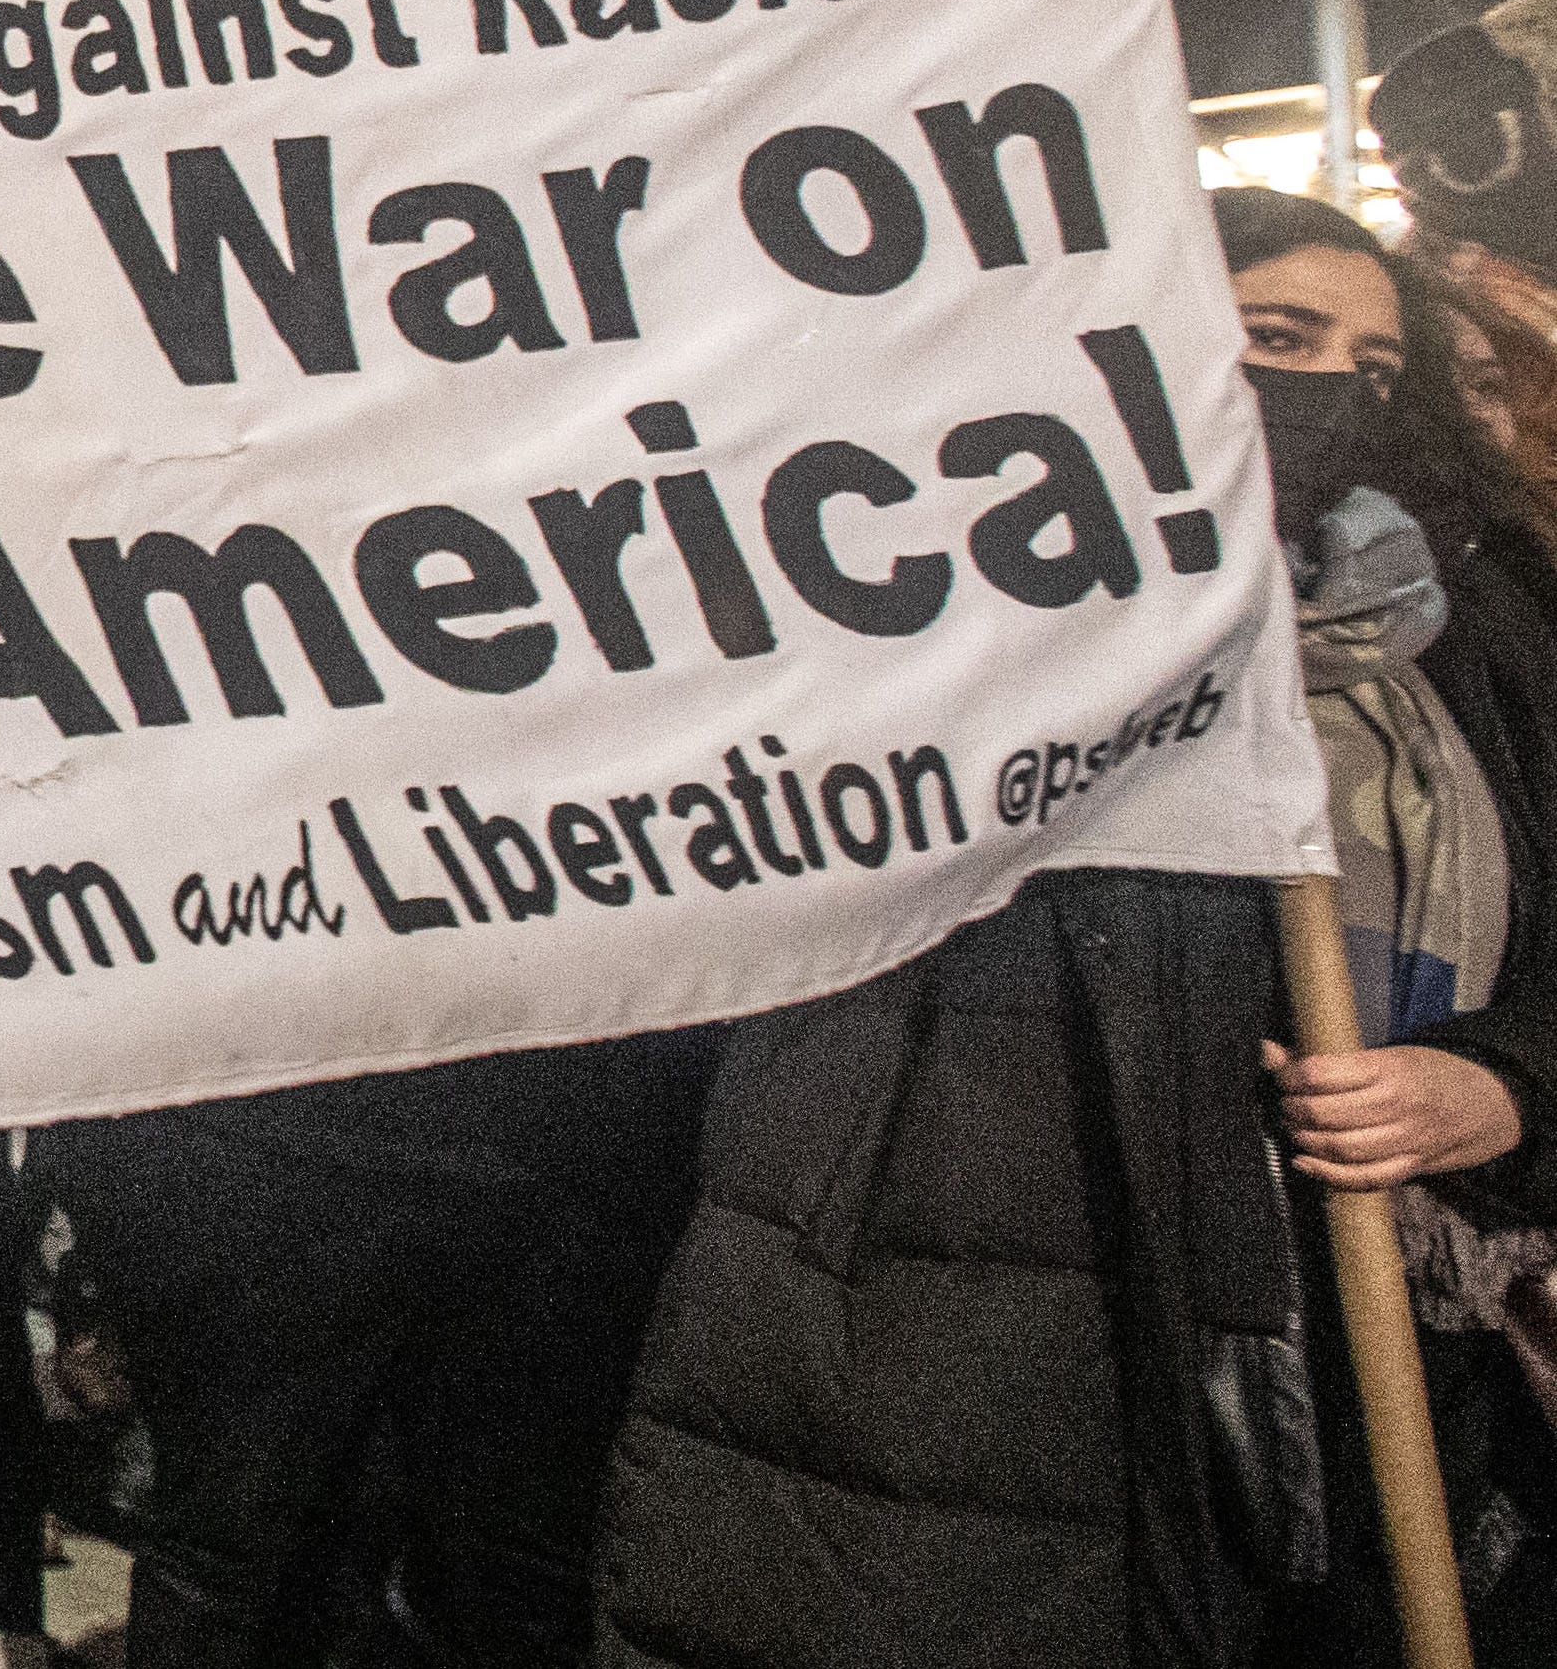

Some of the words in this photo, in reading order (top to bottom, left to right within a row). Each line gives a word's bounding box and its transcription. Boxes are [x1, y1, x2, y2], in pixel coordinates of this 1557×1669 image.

[67, 133, 651, 386] War
[739, 81, 1111, 298] on
[172, 819, 345, 948] and
[329, 733, 970, 937] Liberation
